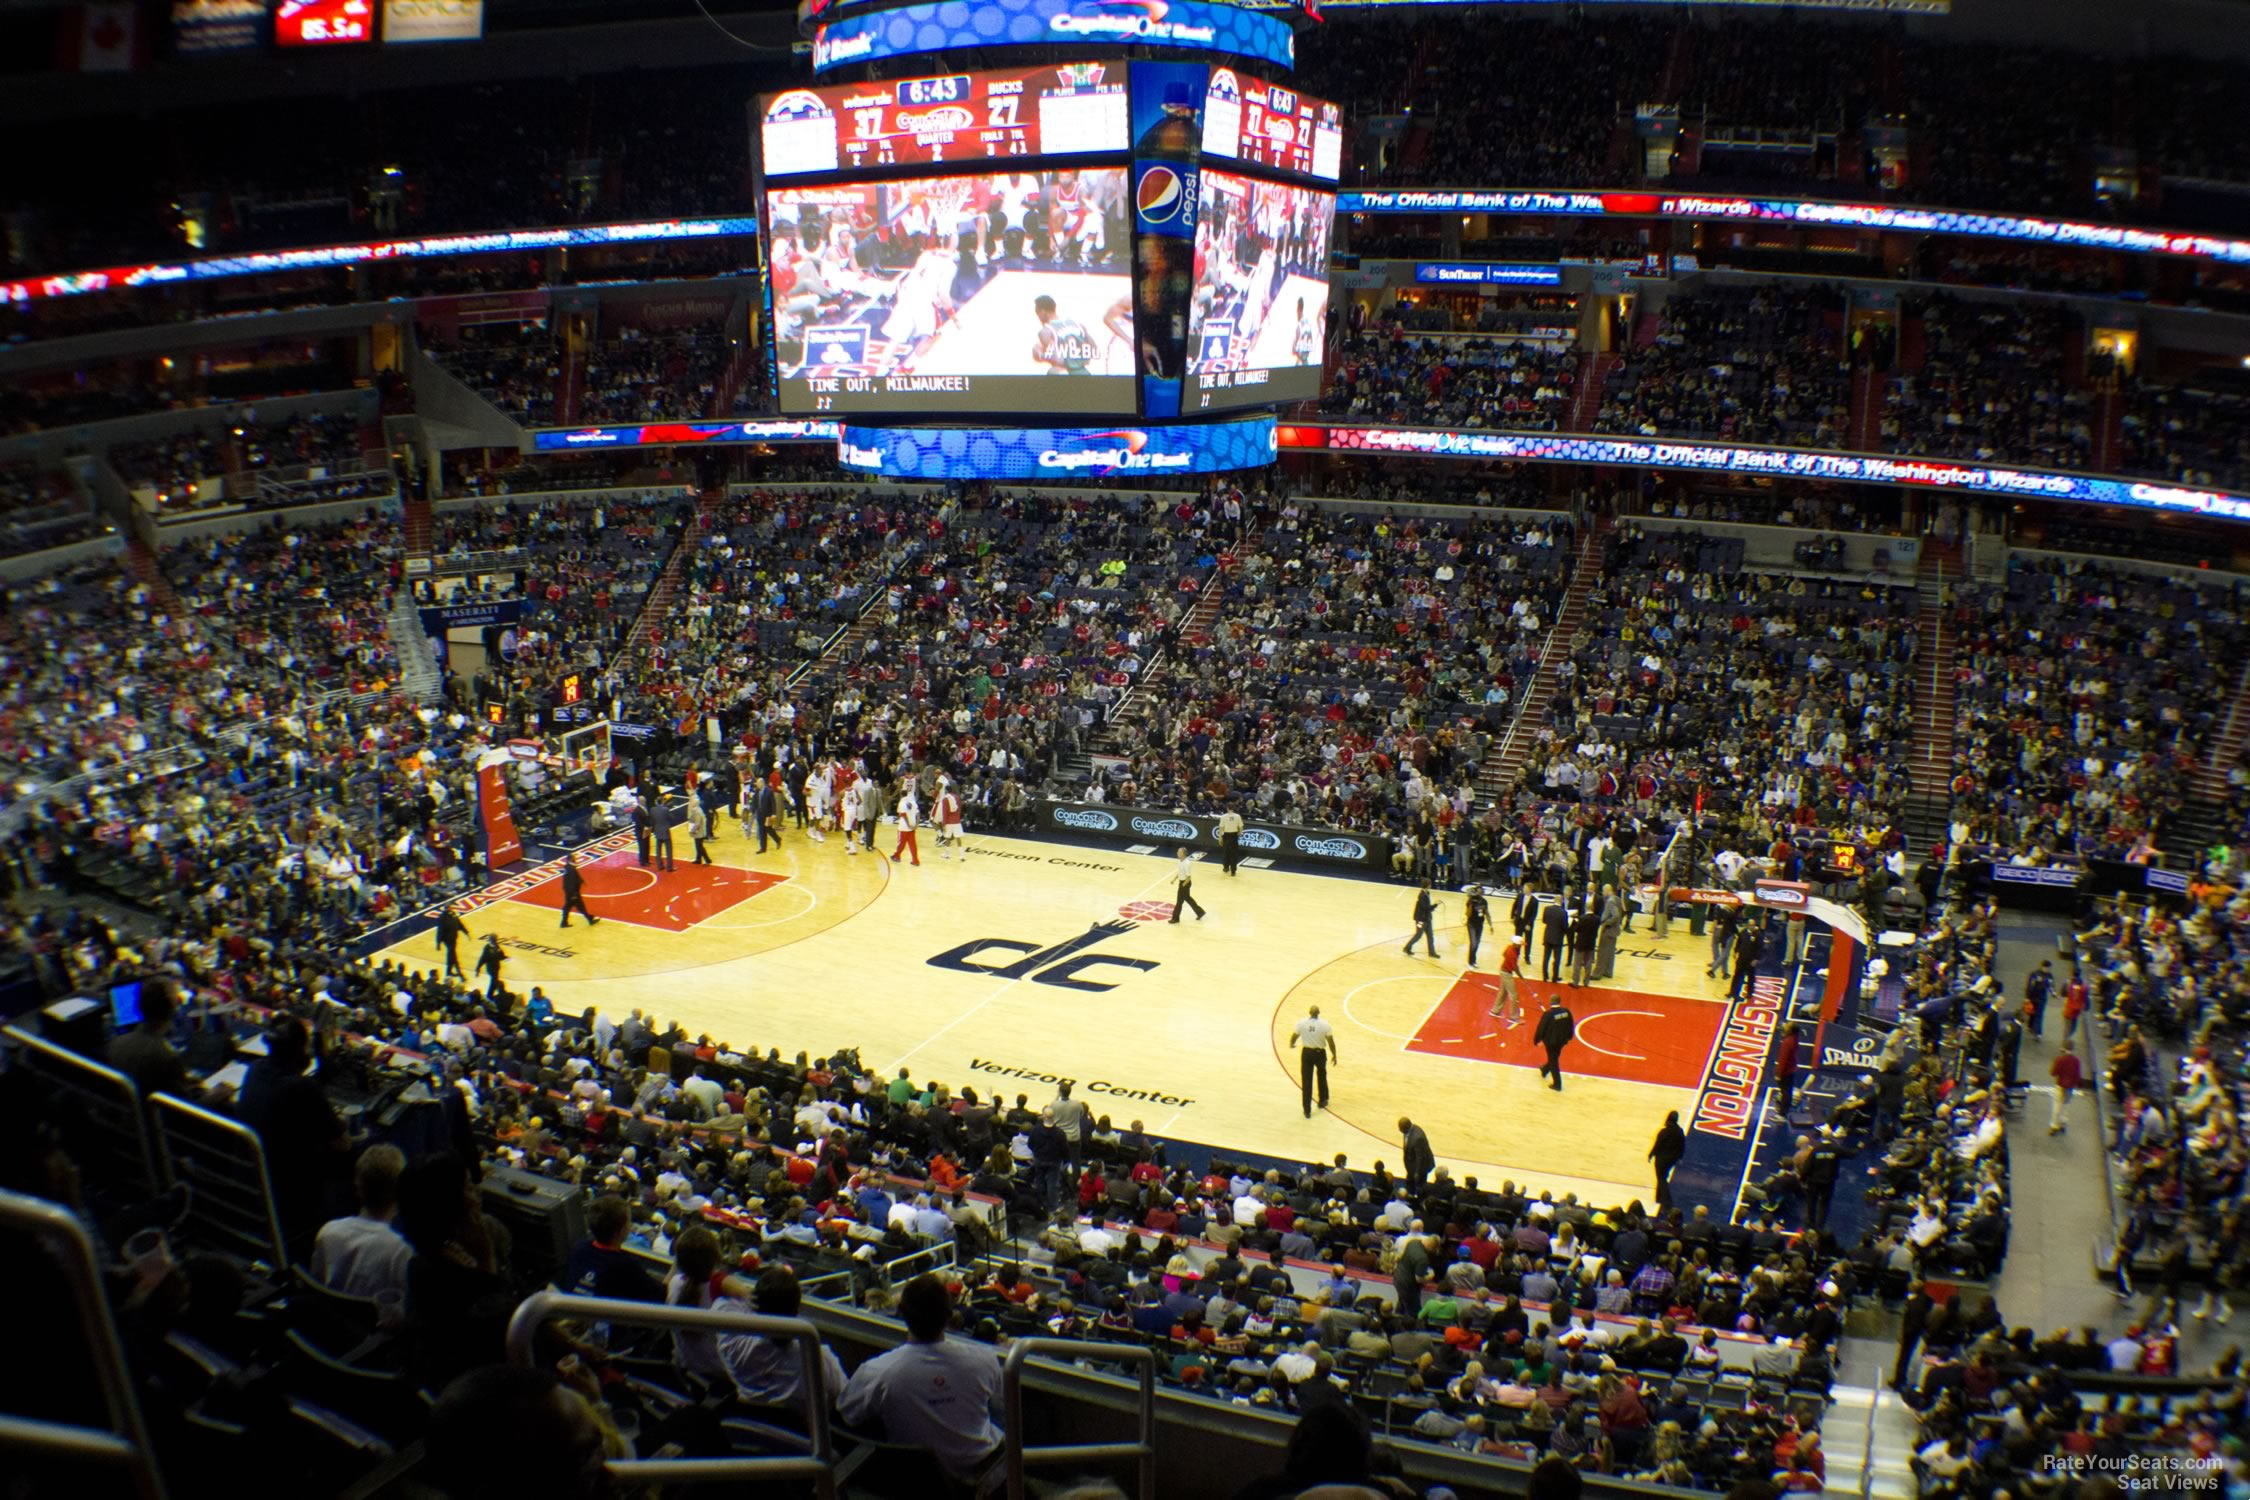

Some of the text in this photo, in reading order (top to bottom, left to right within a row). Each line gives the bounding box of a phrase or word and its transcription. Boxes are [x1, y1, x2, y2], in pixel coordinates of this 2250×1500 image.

[909, 79, 958, 103] 6:43
[988, 80, 1024, 96] BUCKS
[988, 96, 1019, 126] 27
[854, 108, 883, 138] 37
[916, 131, 954, 148] QUARTER
[932, 144, 944, 162] 2
[1182, 173, 1197, 226] pepsi
[1361, 193, 1392, 207] The
[1400, 193, 1457, 208] Official
[1462, 193, 1506, 208] Bank
[1511, 193, 1532, 208] of
[1535, 194, 1567, 208] The
[1679, 198, 1752, 215] Wizards
[808, 375, 970, 394] TIME OUT, MILWAUKEE!
[1470, 439, 1517, 454] Bank
[1150, 452, 1193, 467] Bank
[1613, 443, 2074, 493] The Official Bank of The Washington Wizards
[441, 606, 499, 618] MASERATI
[1064, 820, 1109, 831] SPORTSNET
[1142, 828, 1188, 840] SPORTSNET
[964, 846, 1124, 873] Verizon Center
[1306, 847, 1357, 859] SPORTSNET
[970, 1058, 1196, 1108] Verizon Center
